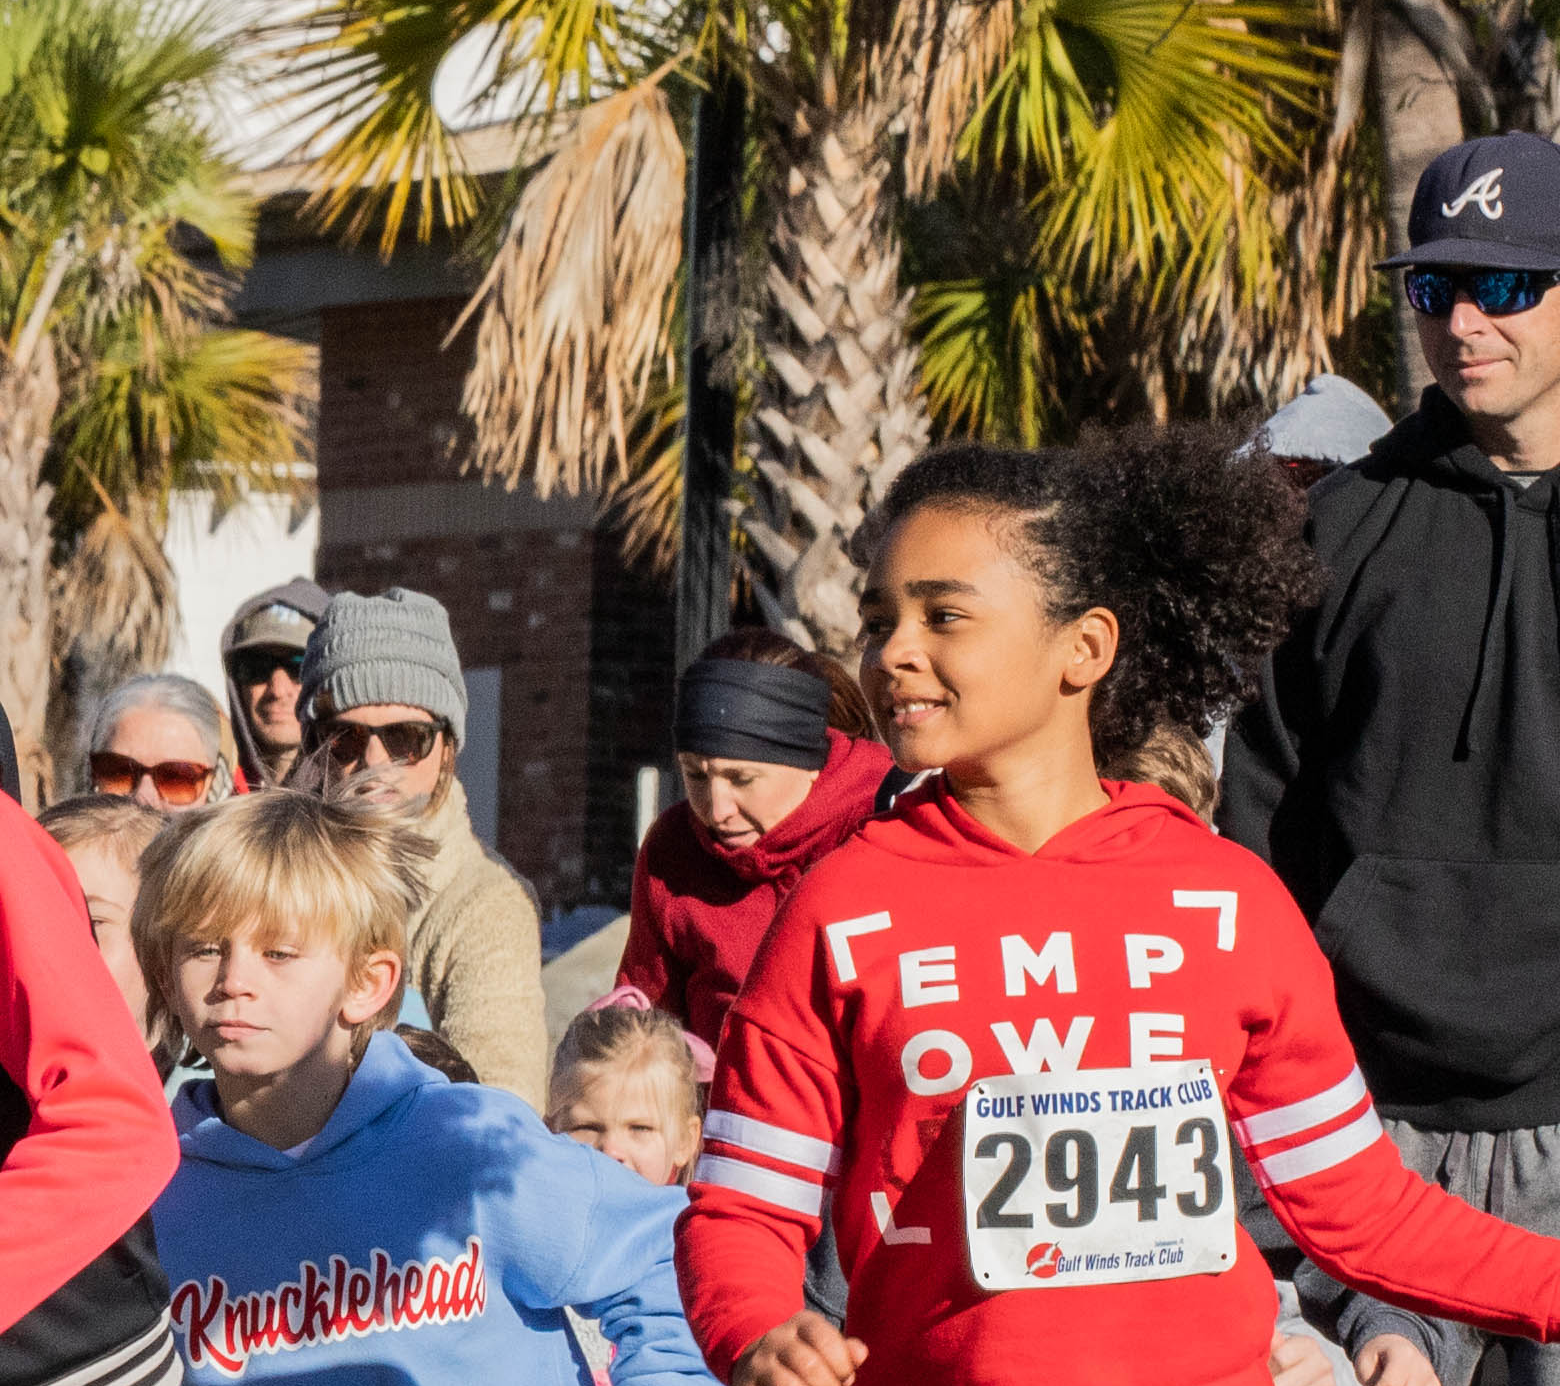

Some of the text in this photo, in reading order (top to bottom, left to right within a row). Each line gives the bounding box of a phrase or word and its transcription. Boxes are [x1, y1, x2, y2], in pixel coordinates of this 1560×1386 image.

[1442, 167, 1503, 220] A
[976, 1079, 1213, 1118] GULF WINDS TRACK CLUB
[974, 1117, 1223, 1229] 2943
[1057, 1248, 1184, 1273] Gulf Winds Track Club
[170, 1237, 487, 1377] Knuckleheads
